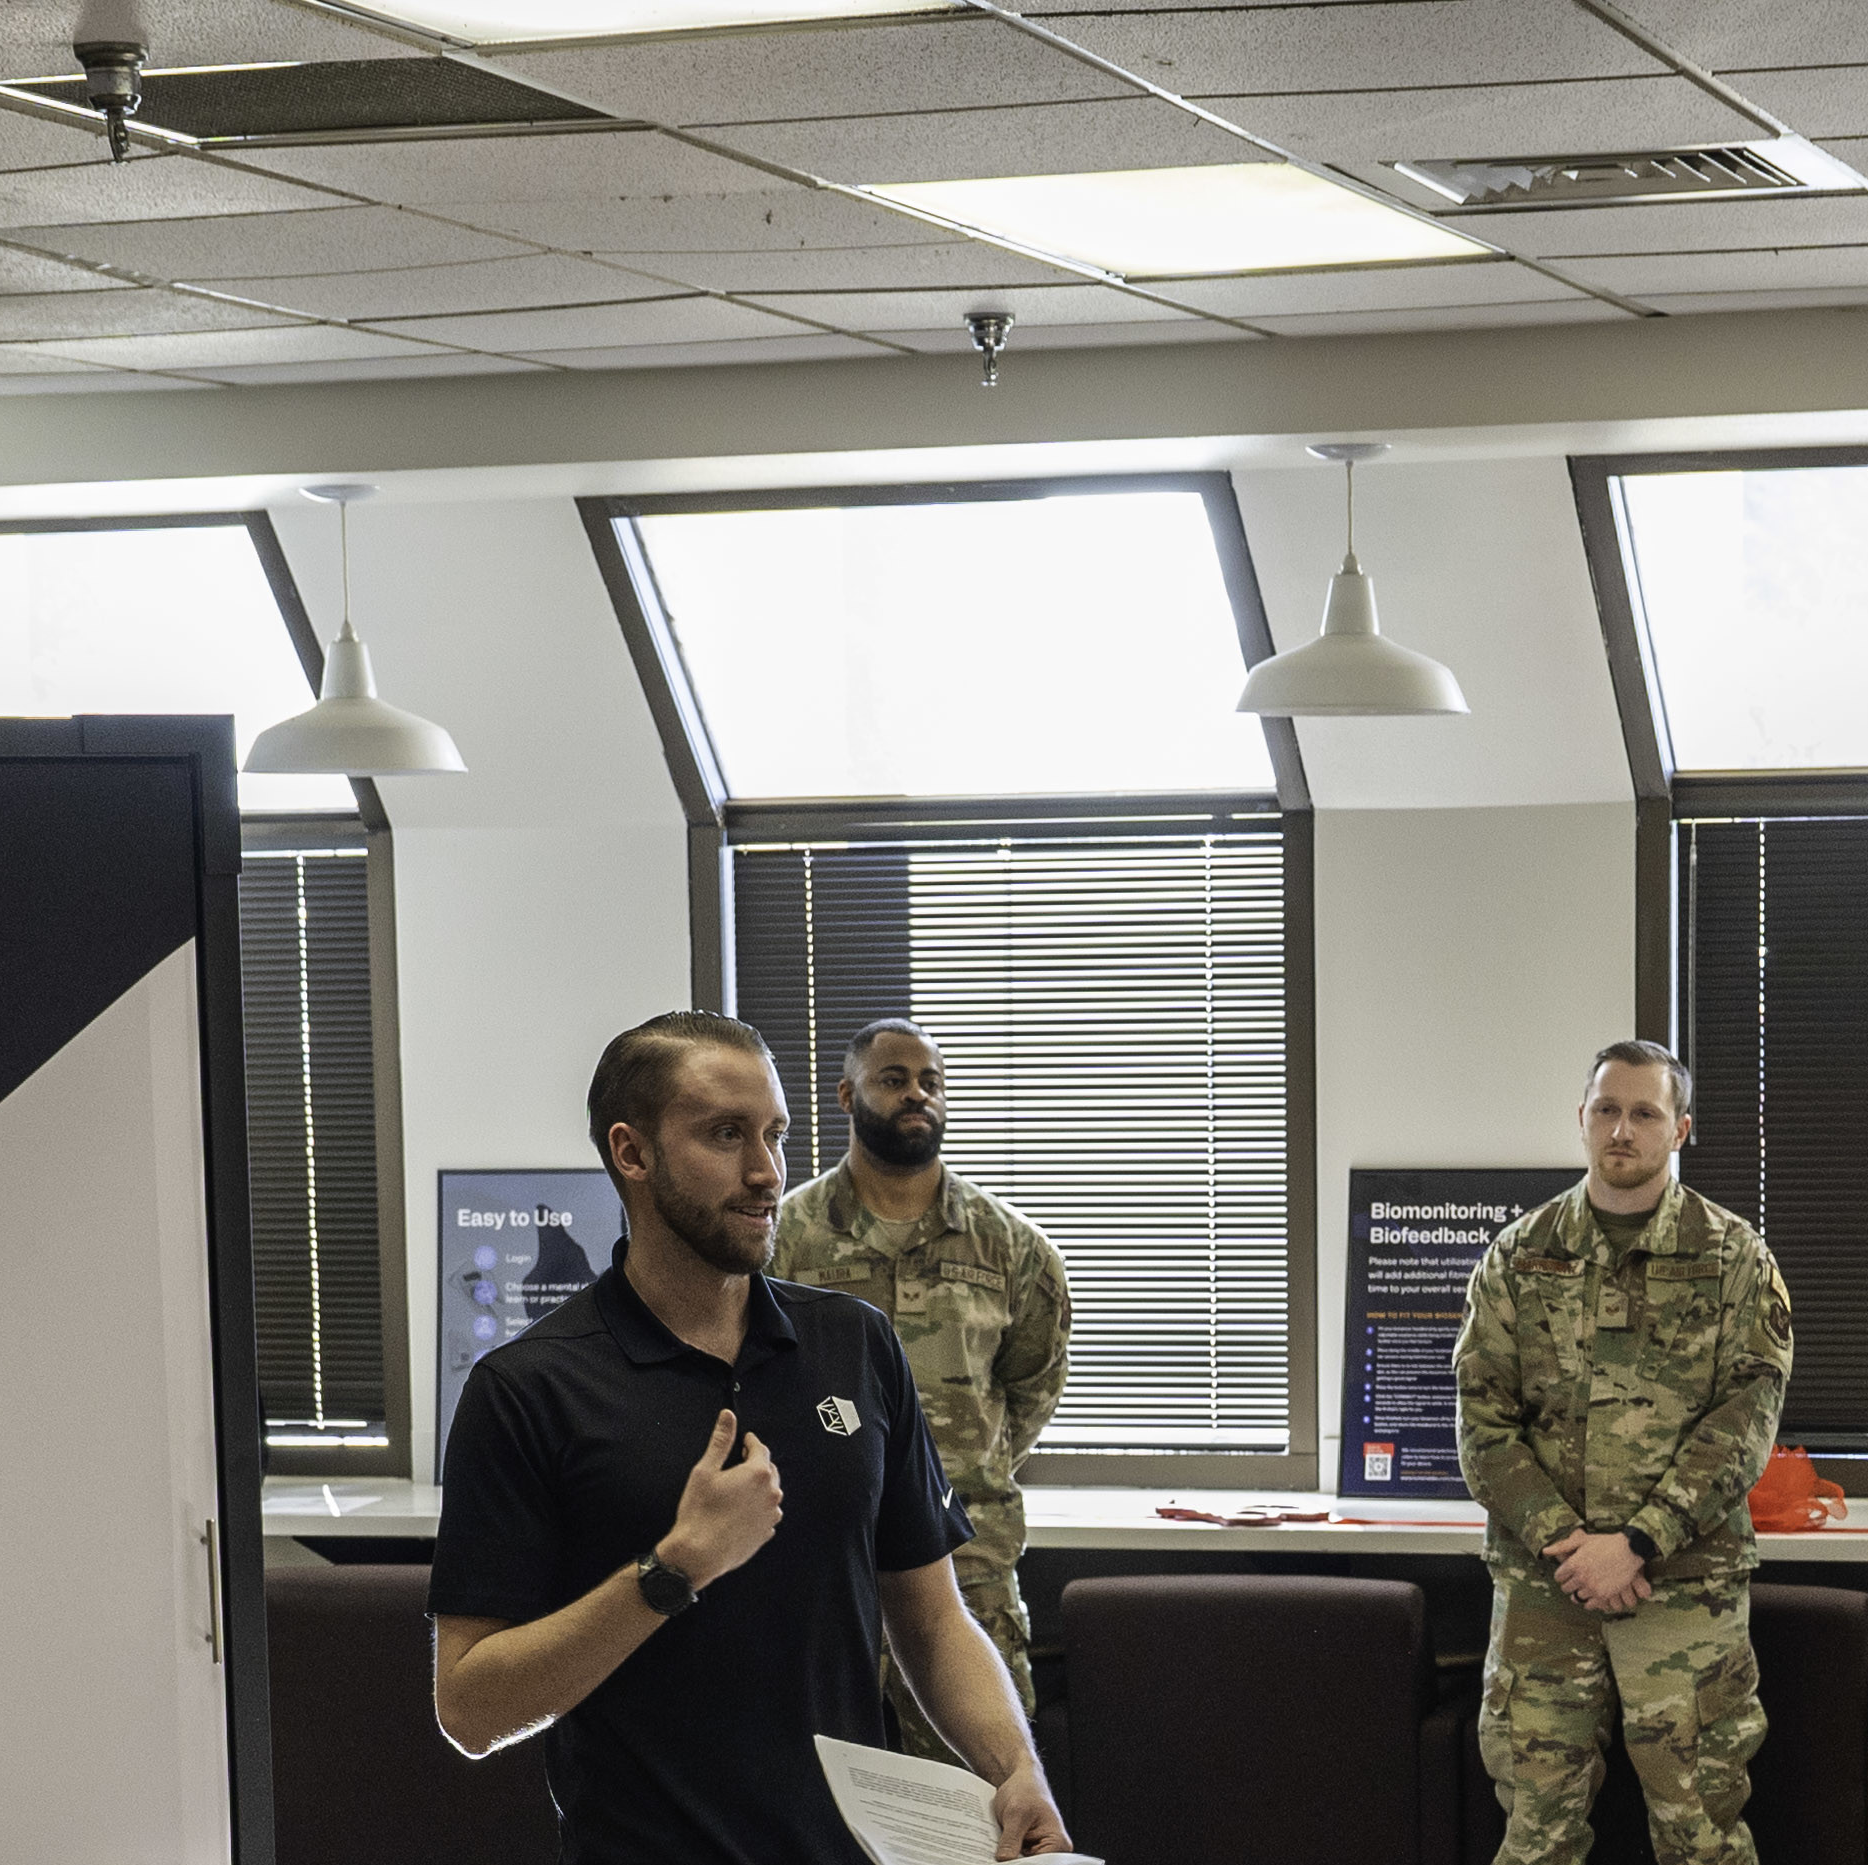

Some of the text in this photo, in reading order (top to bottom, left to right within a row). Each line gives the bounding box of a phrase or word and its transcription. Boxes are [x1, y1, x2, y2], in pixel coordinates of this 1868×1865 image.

[1371, 1202, 1523, 1224] Biomonitoring +
[457, 1209, 573, 1231] Easy to Use
[1370, 1226, 1490, 1245] Biofeedback
[1368, 1256, 1397, 1266] Please
[1399, 1257, 1419, 1266] note
[1421, 1256, 1439, 1266] that
[1368, 1270, 1383, 1279] will
[1384, 1270, 1402, 1279] add
[548, 1282, 580, 1292] mental
[1367, 1284, 1388, 1293] time
[1390, 1285, 1400, 1293] to
[1401, 1286, 1420, 1295] your
[1421, 1285, 1451, 1294] overall
